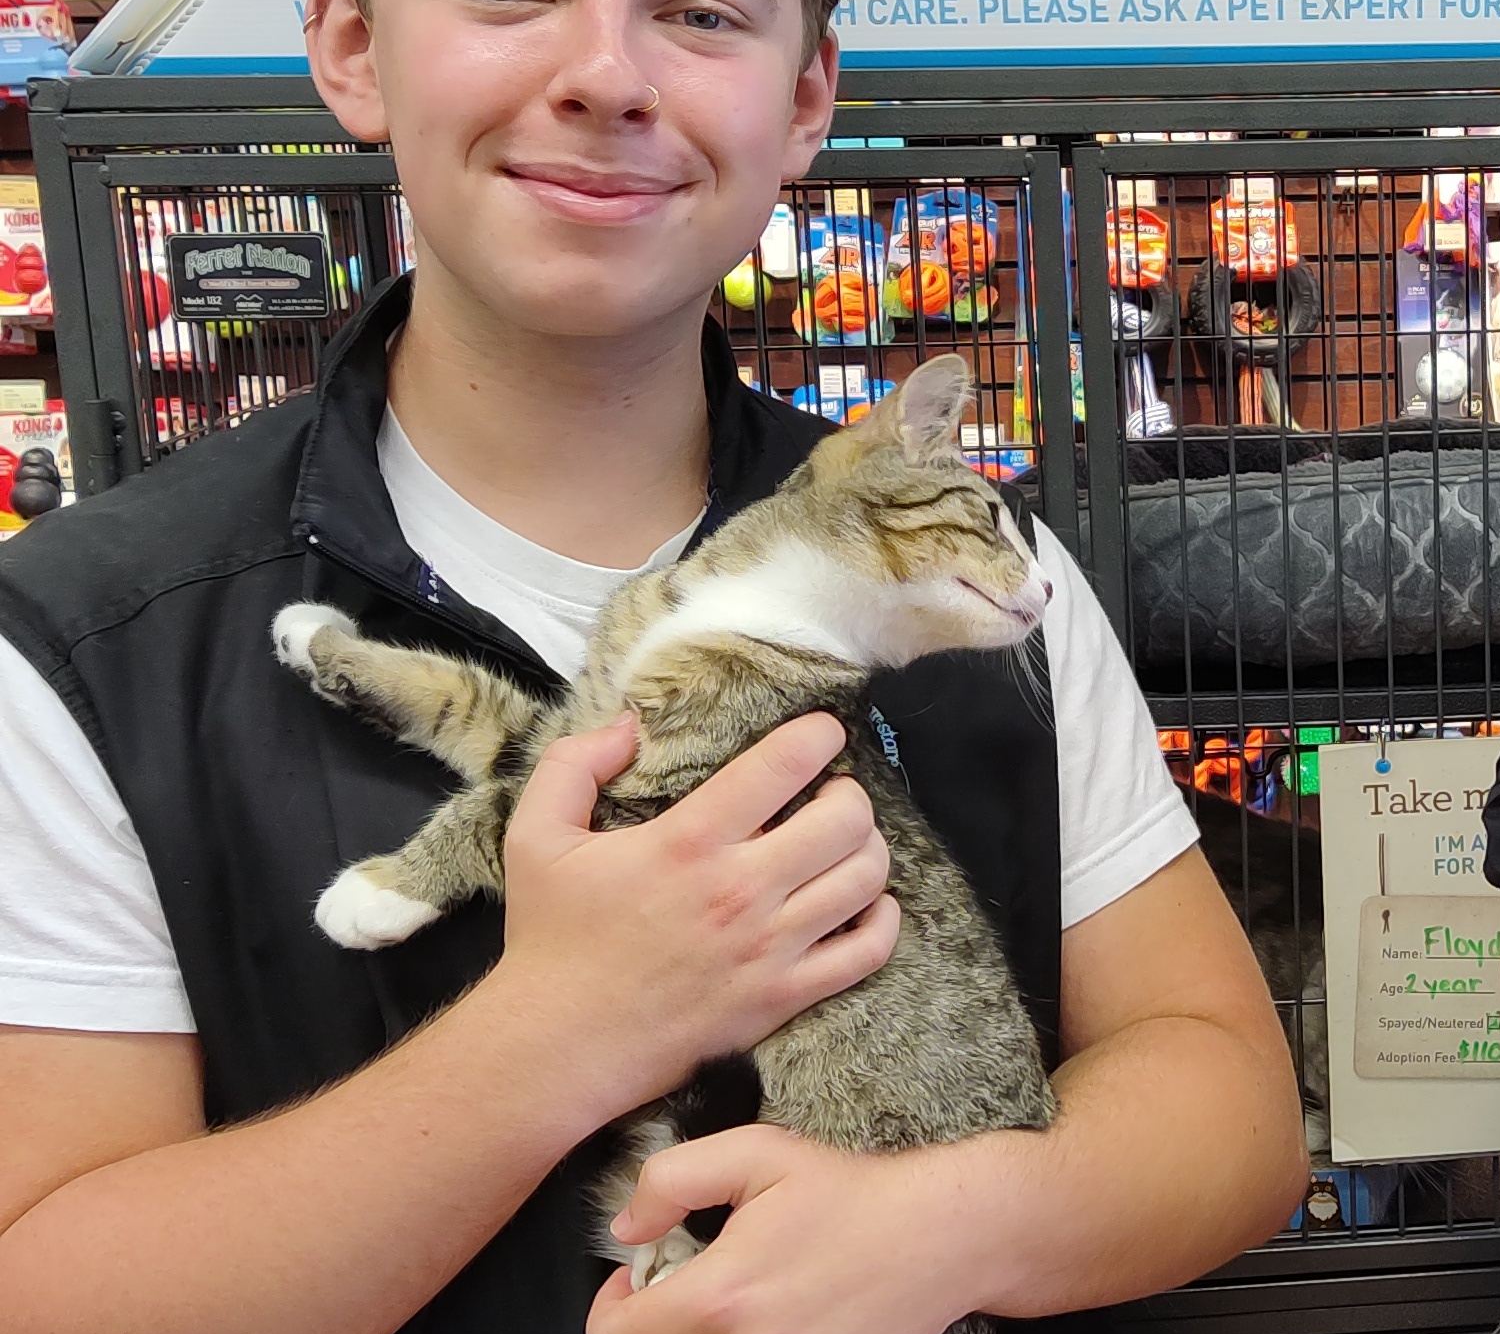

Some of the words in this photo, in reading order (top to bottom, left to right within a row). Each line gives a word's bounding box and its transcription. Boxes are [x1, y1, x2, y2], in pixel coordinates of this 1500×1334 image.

[184, 243, 243, 280] Ferret
[245, 242, 311, 279] Nation
[1363, 779, 1453, 816] Take
[1434, 835, 1466, 854] I'M
[1434, 857, 1475, 875] FOR
[1382, 946, 1423, 959] Name:
[1423, 977, 1484, 999] year
[1378, 1016, 1484, 1031] Spayed/Neutered
[1376, 1050, 1432, 1066] Adoption
